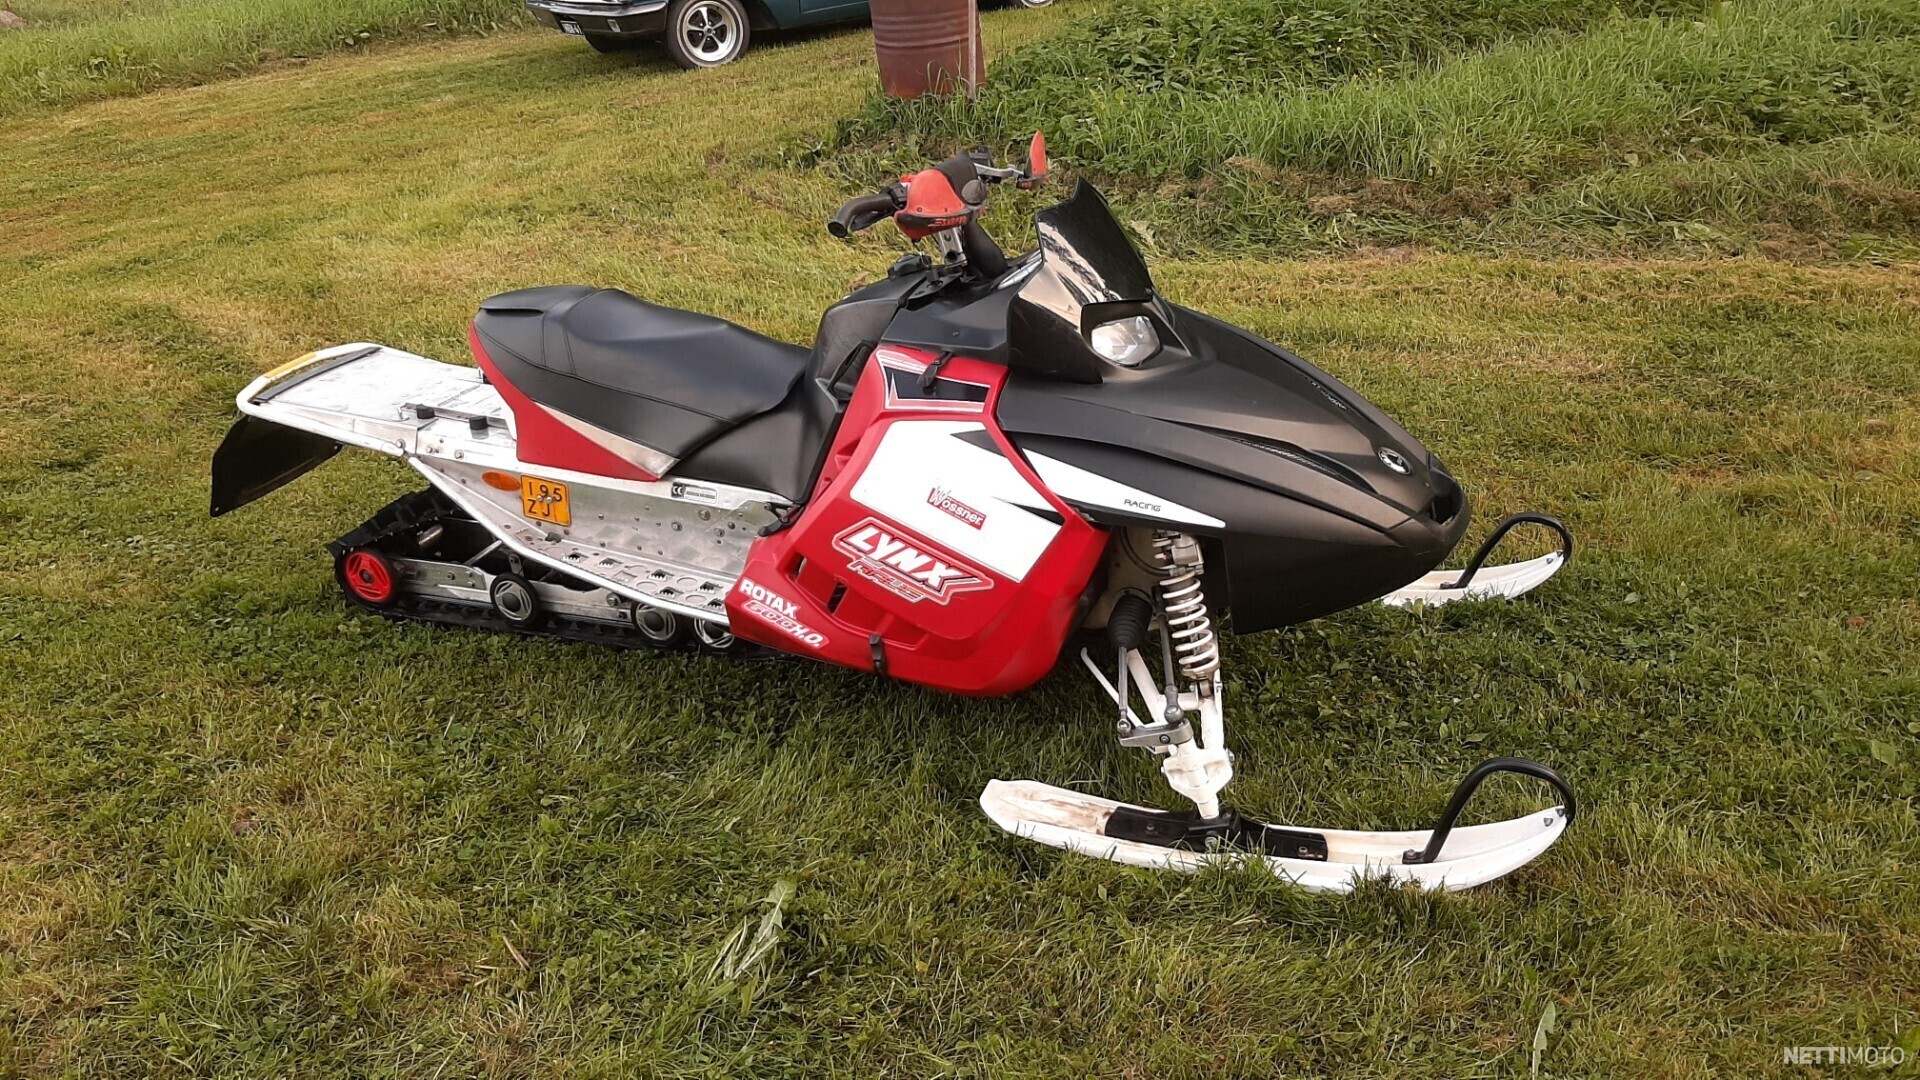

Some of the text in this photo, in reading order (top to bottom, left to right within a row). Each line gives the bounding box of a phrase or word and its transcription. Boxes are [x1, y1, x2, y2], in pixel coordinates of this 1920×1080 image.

[529, 482, 563, 502] 195
[1124, 499, 1162, 512] RACING
[846, 527, 963, 588] LYNX
[740, 579, 798, 619] ROTAX
